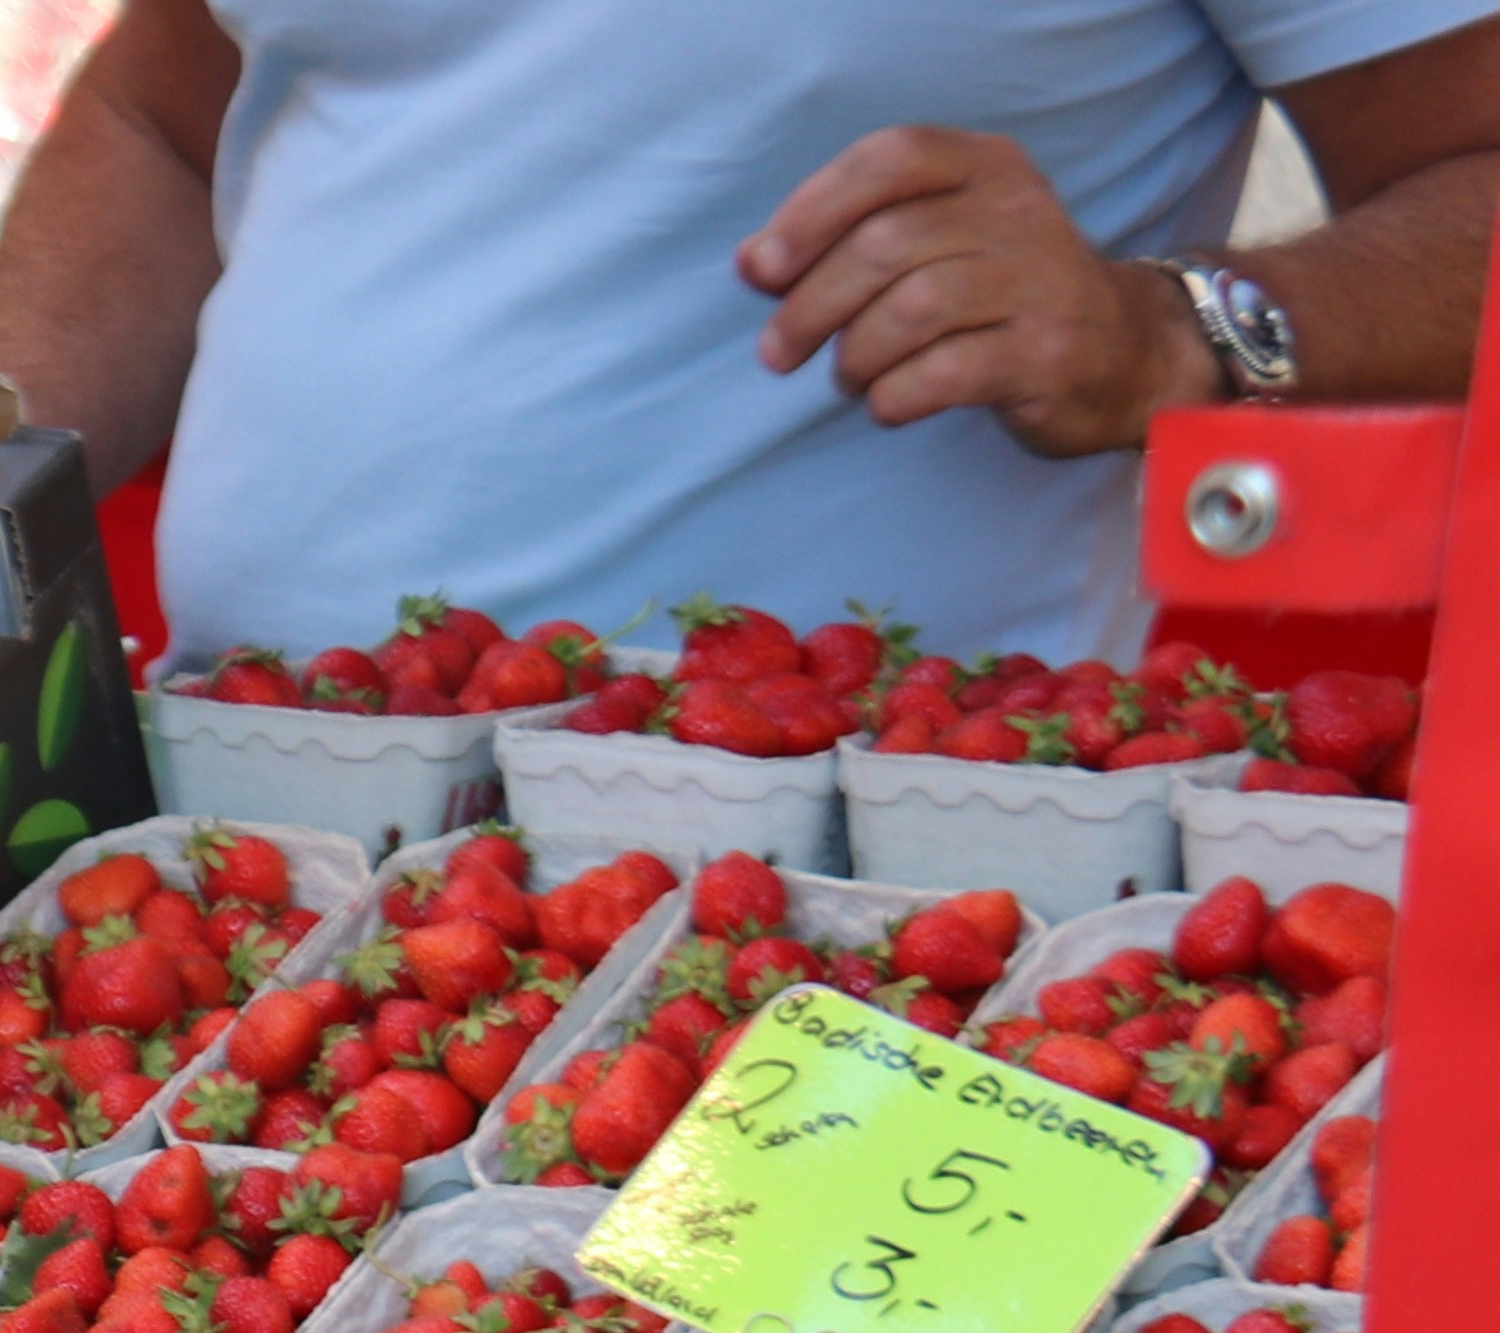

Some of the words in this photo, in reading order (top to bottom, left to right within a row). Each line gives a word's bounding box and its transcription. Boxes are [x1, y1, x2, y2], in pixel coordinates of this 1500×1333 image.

[771, 988, 945, 1094] Badische
[956, 1073, 1167, 1182] Erdbeeren
[902, 1147, 1028, 1238] 5,-
[830, 1234, 940, 1319] 3,-
